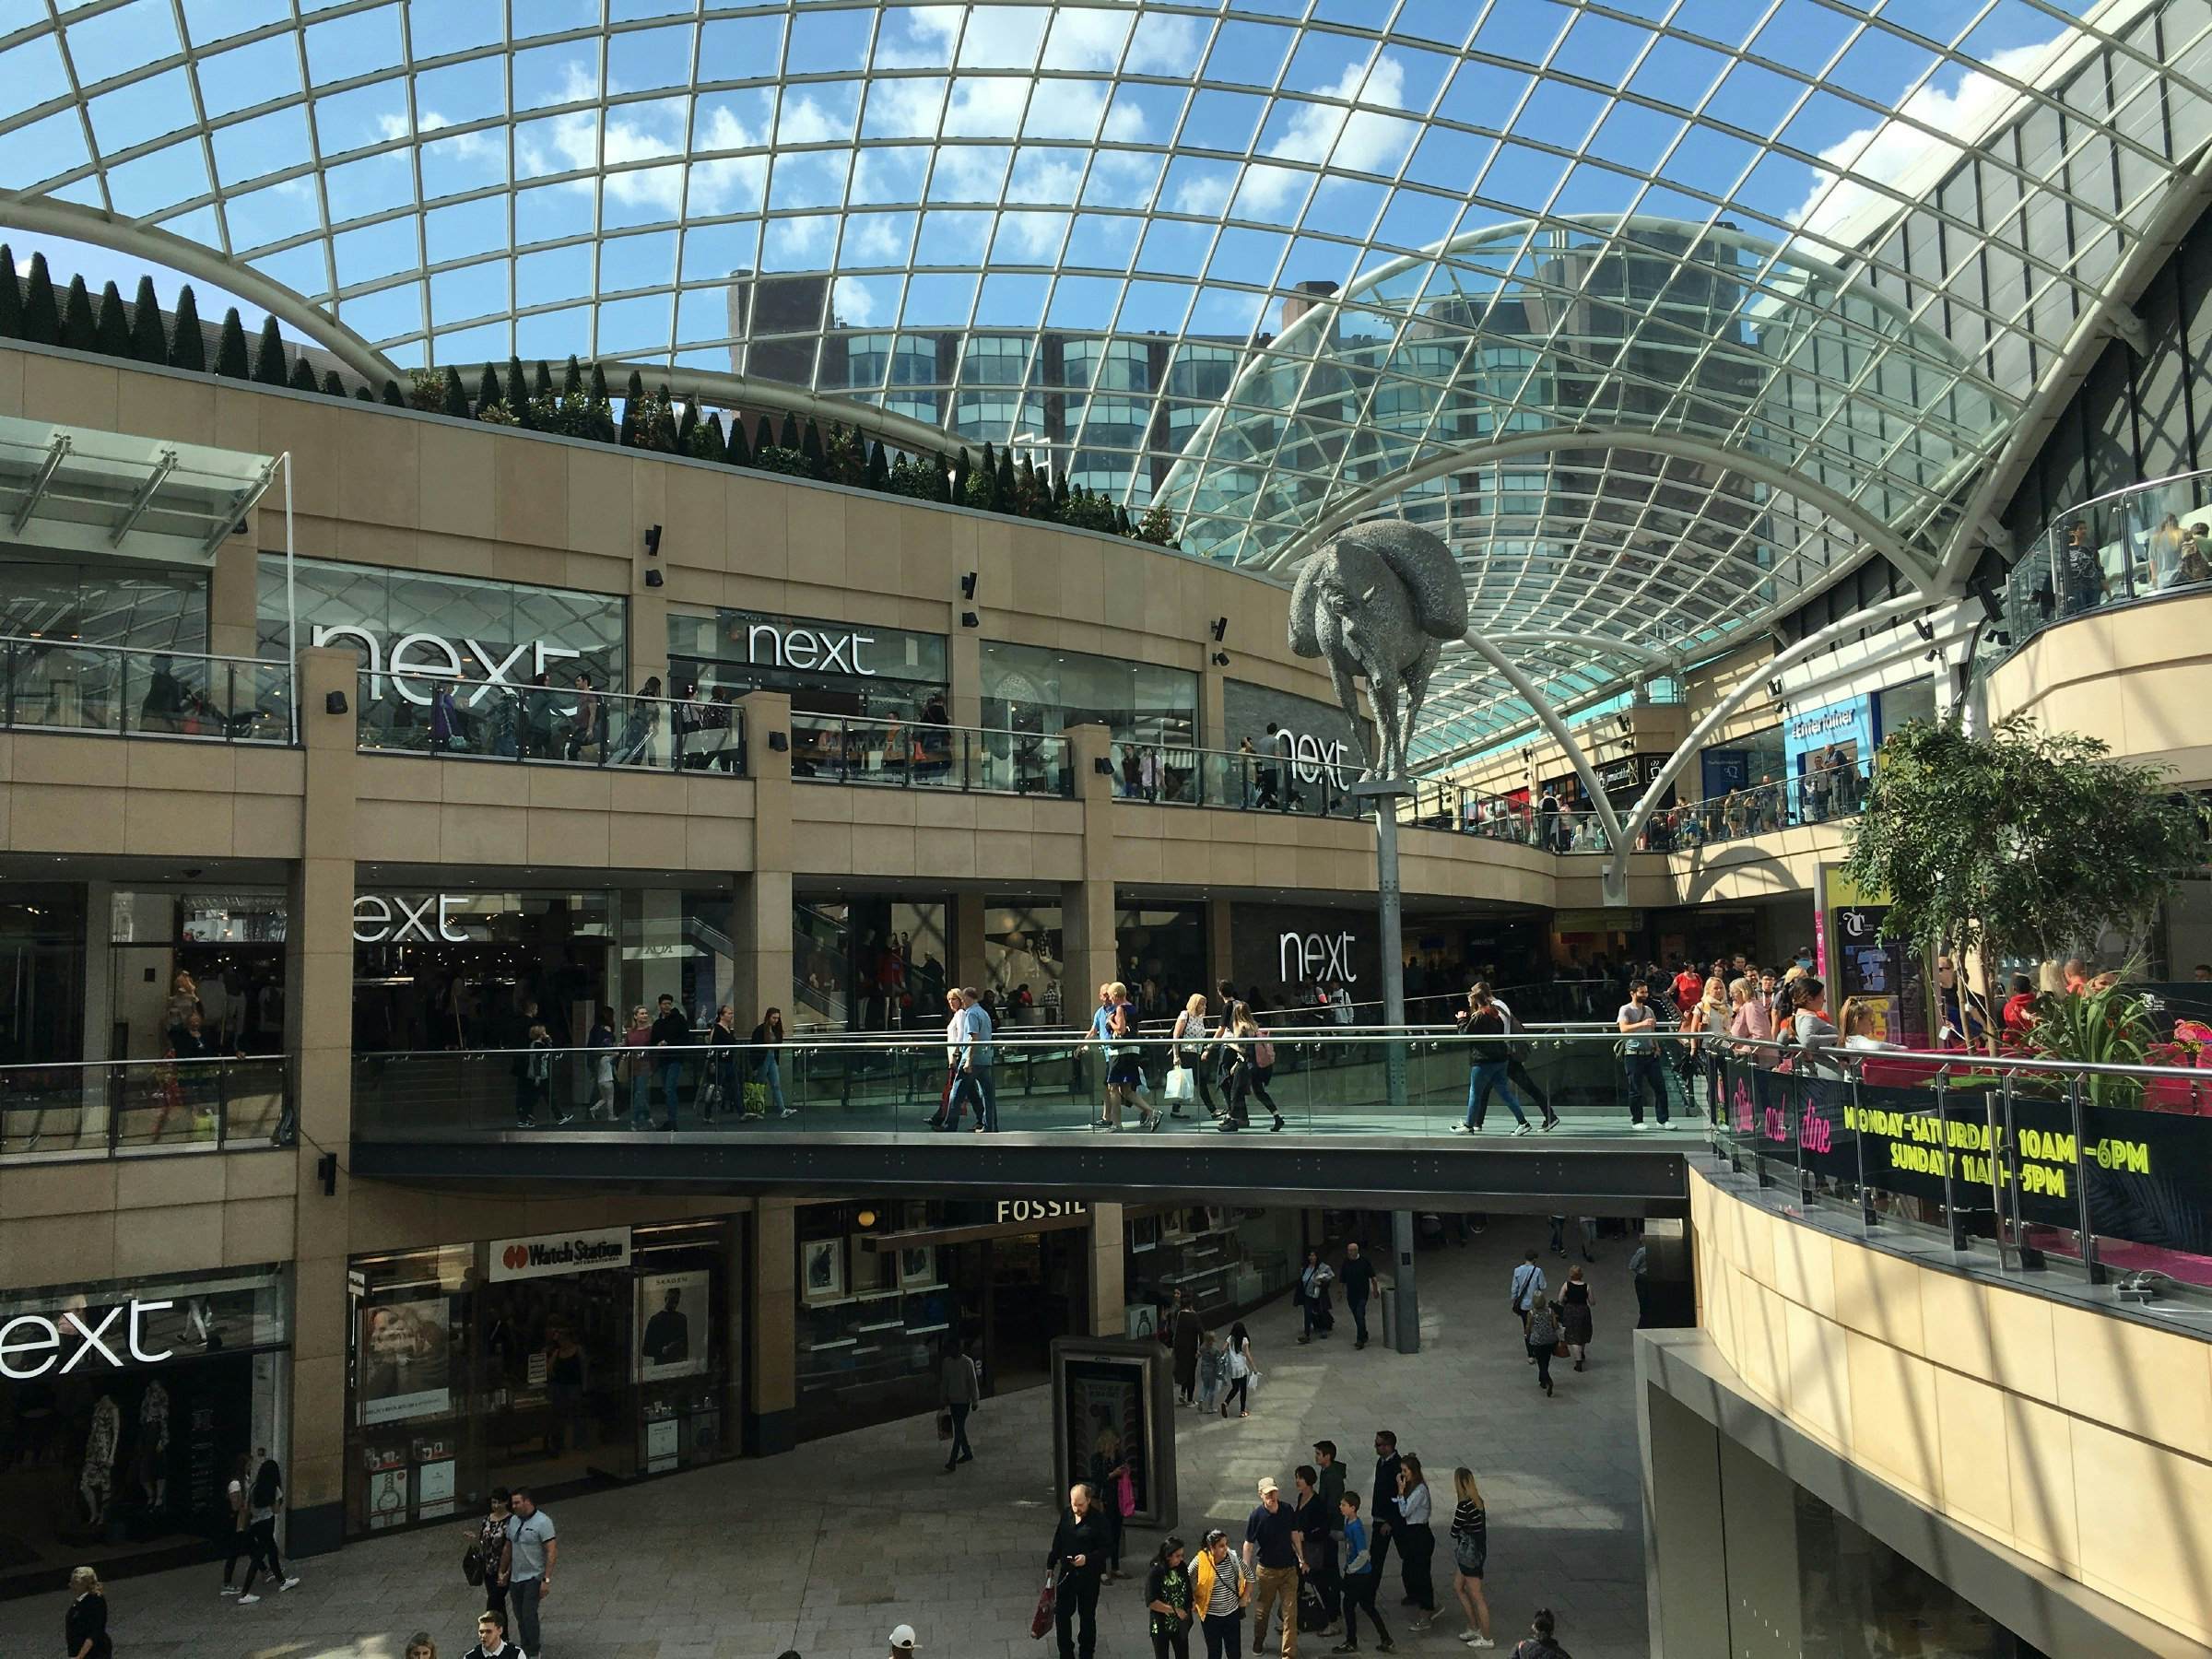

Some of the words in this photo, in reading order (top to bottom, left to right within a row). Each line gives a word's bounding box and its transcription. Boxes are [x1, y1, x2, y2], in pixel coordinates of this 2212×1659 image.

[313, 625, 581, 716] next
[748, 625, 877, 676] next
[1276, 728, 1350, 792] next
[353, 893, 470, 942] ext
[1279, 930, 1357, 982] next
[1801, 1098, 1831, 1153] dine
[1890, 1142, 1954, 1180] SUNDAY
[997, 1200, 1086, 1223] FOSSIL
[528, 1241, 573, 1266] Watch
[574, 1240, 623, 1261] Station
[0, 1299, 173, 1379] ext
